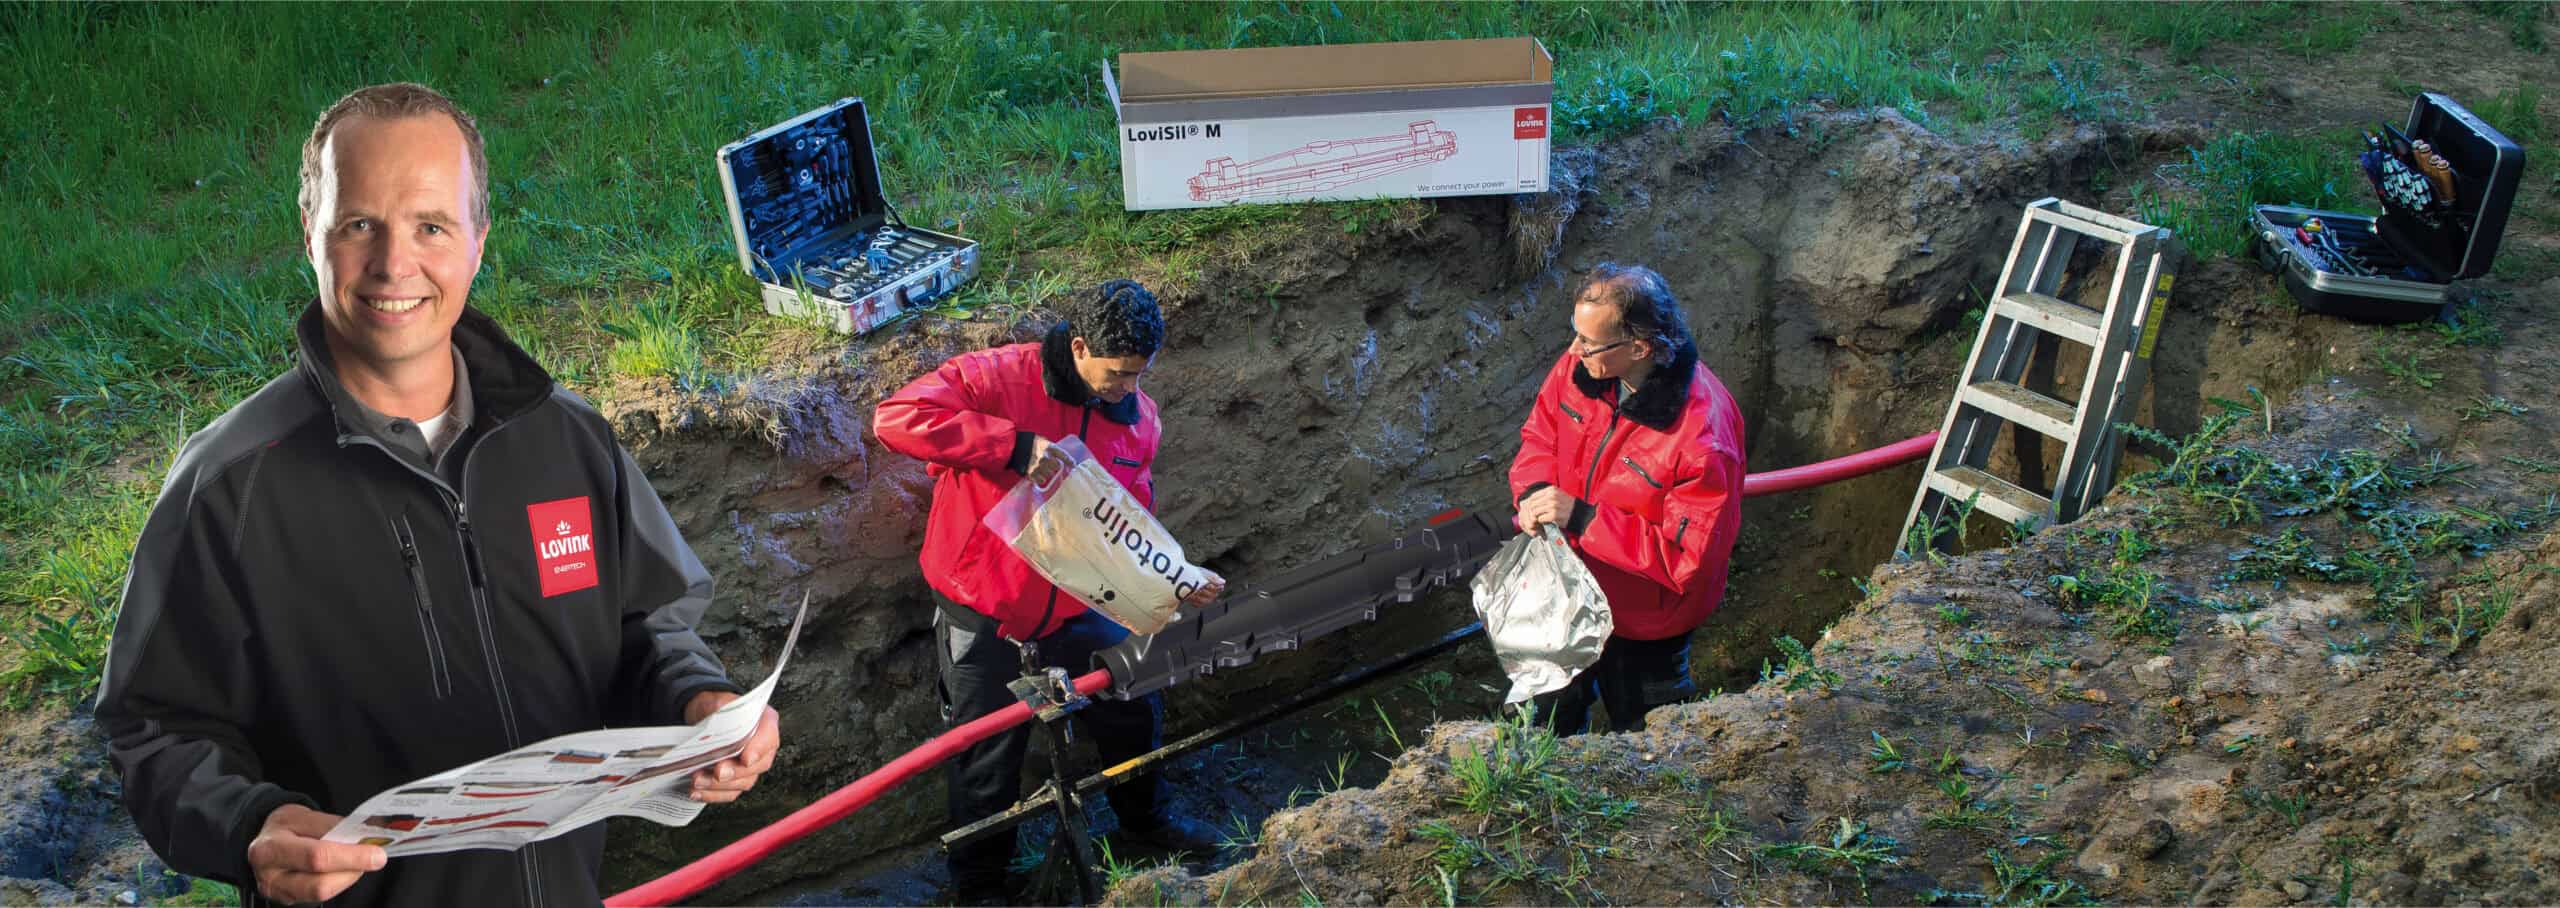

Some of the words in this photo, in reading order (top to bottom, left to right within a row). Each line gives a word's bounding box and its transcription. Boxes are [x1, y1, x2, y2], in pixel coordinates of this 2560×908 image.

[1206, 123, 1221, 138] M
[1417, 183, 1430, 192] We
[1431, 183, 1461, 191] connect
[1463, 182, 1480, 192] your
[540, 534, 591, 559] LOVINK
